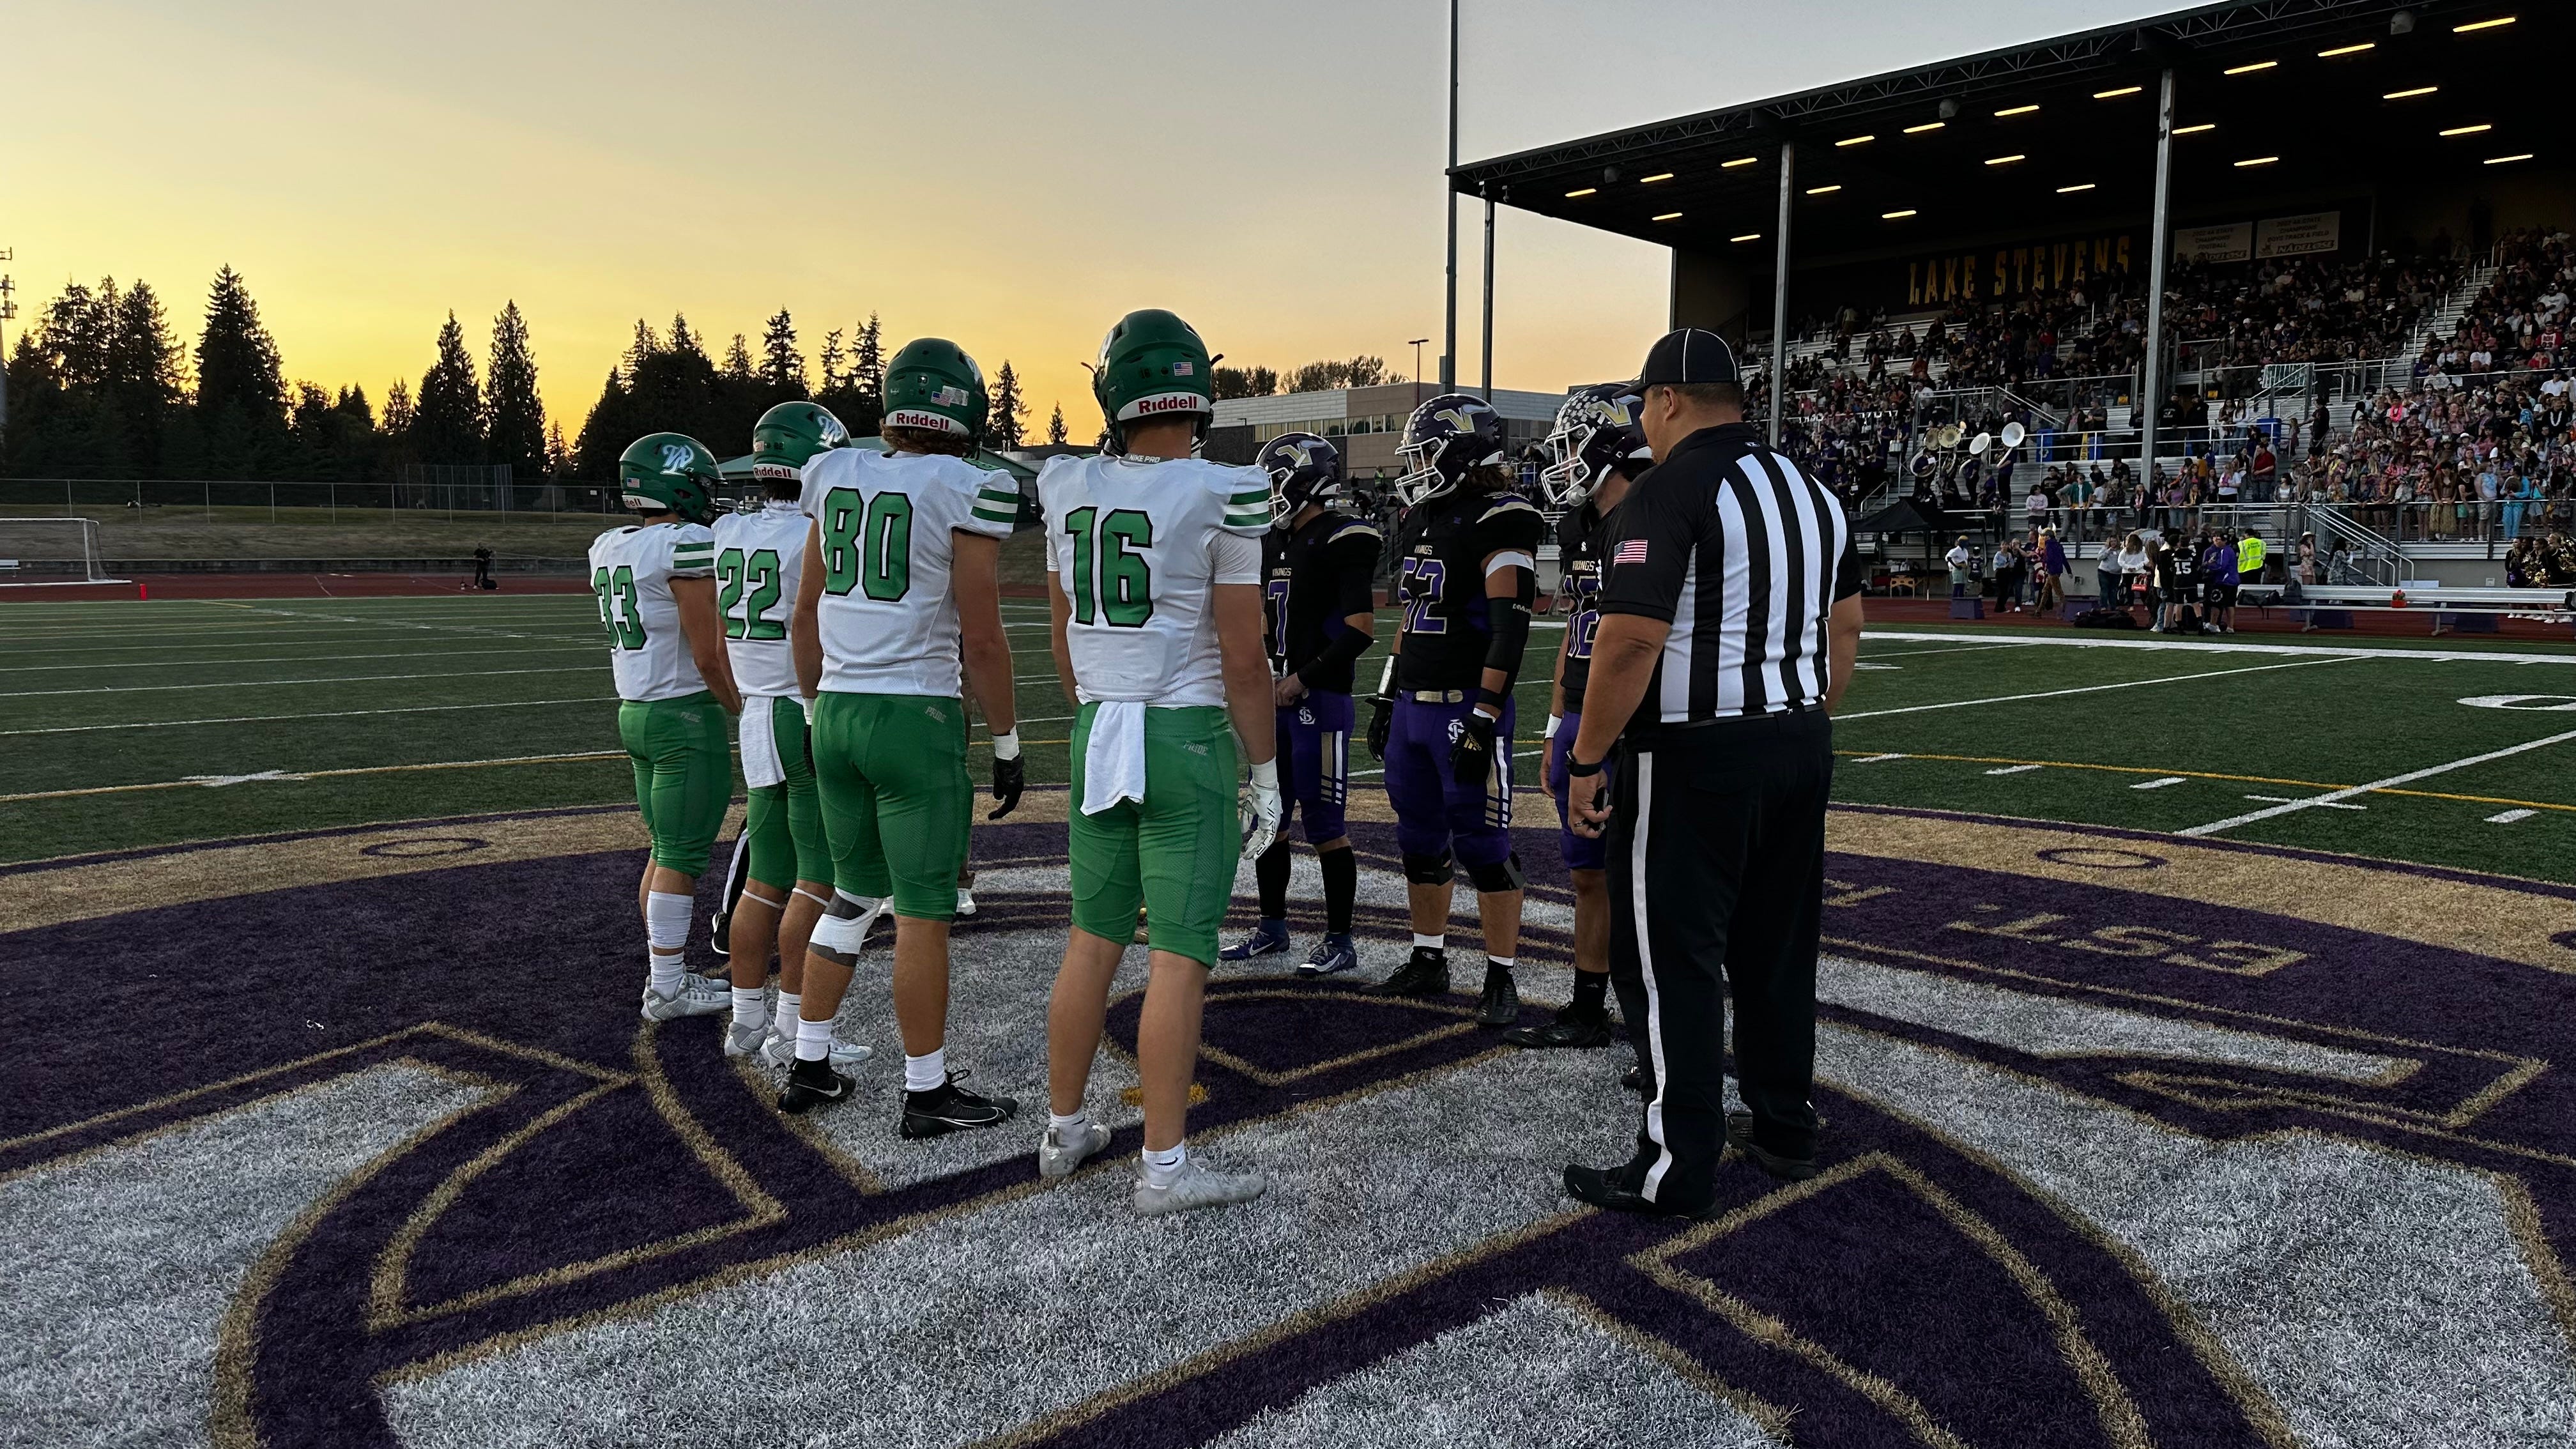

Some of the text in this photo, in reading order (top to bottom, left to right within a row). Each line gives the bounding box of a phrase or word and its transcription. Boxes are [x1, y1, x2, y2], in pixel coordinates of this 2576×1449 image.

[2285, 232, 2306, 240] TRACK
[2197, 241, 2227, 250] FOOTBALL
[1908, 234, 2131, 305] LAKE STEVENS
[1138, 395, 1197, 414] Riddell
[896, 413, 949, 431] Riddell
[1129, 454, 1144, 463] NIKE
[754, 467, 792, 479] Riddell
[824, 487, 913, 602] 80
[1065, 506, 1153, 627] 16
[1572, 560, 1595, 571] VIKINGS
[2174, 562, 2191, 574] 15
[717, 548, 786, 640] 22
[1398, 556, 1448, 634] 52
[594, 565, 647, 650] 33
[1268, 579, 1290, 656] 7
[925, 706, 947, 723] PRIDE
